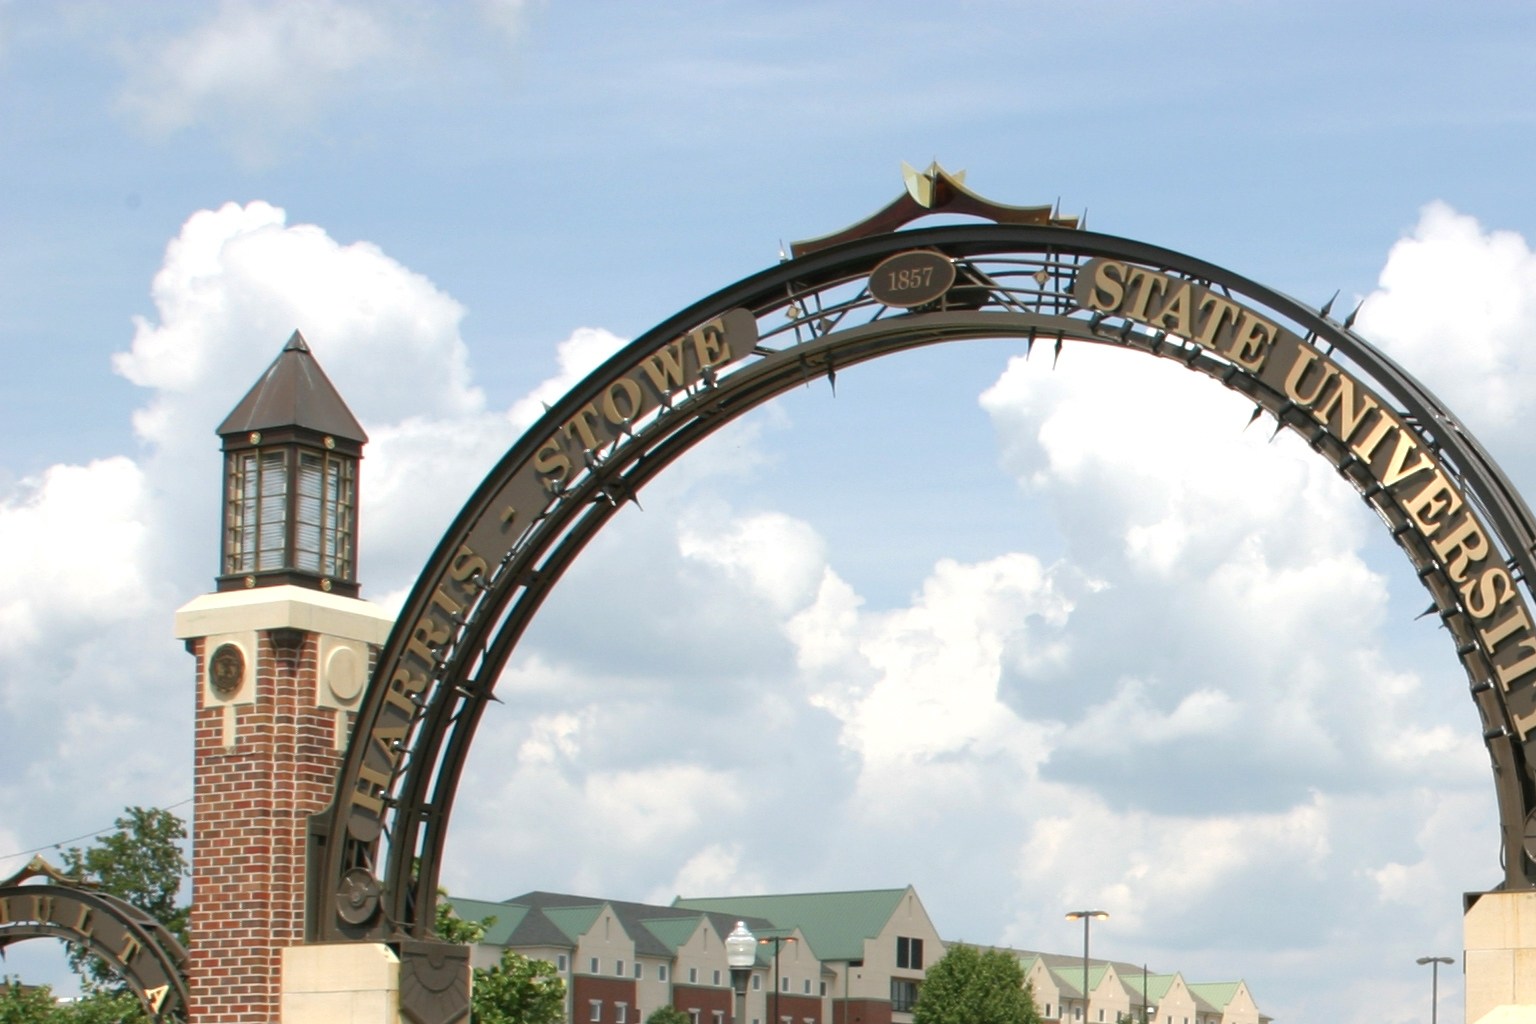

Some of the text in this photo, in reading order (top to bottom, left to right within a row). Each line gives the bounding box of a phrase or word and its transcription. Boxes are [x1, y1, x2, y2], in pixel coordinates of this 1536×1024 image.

[888, 266, 934, 292] 1857
[351, 545, 488, 818] HARRIS
[534, 317, 731, 493] STOWE
[1087, 261, 1278, 371] STATE
